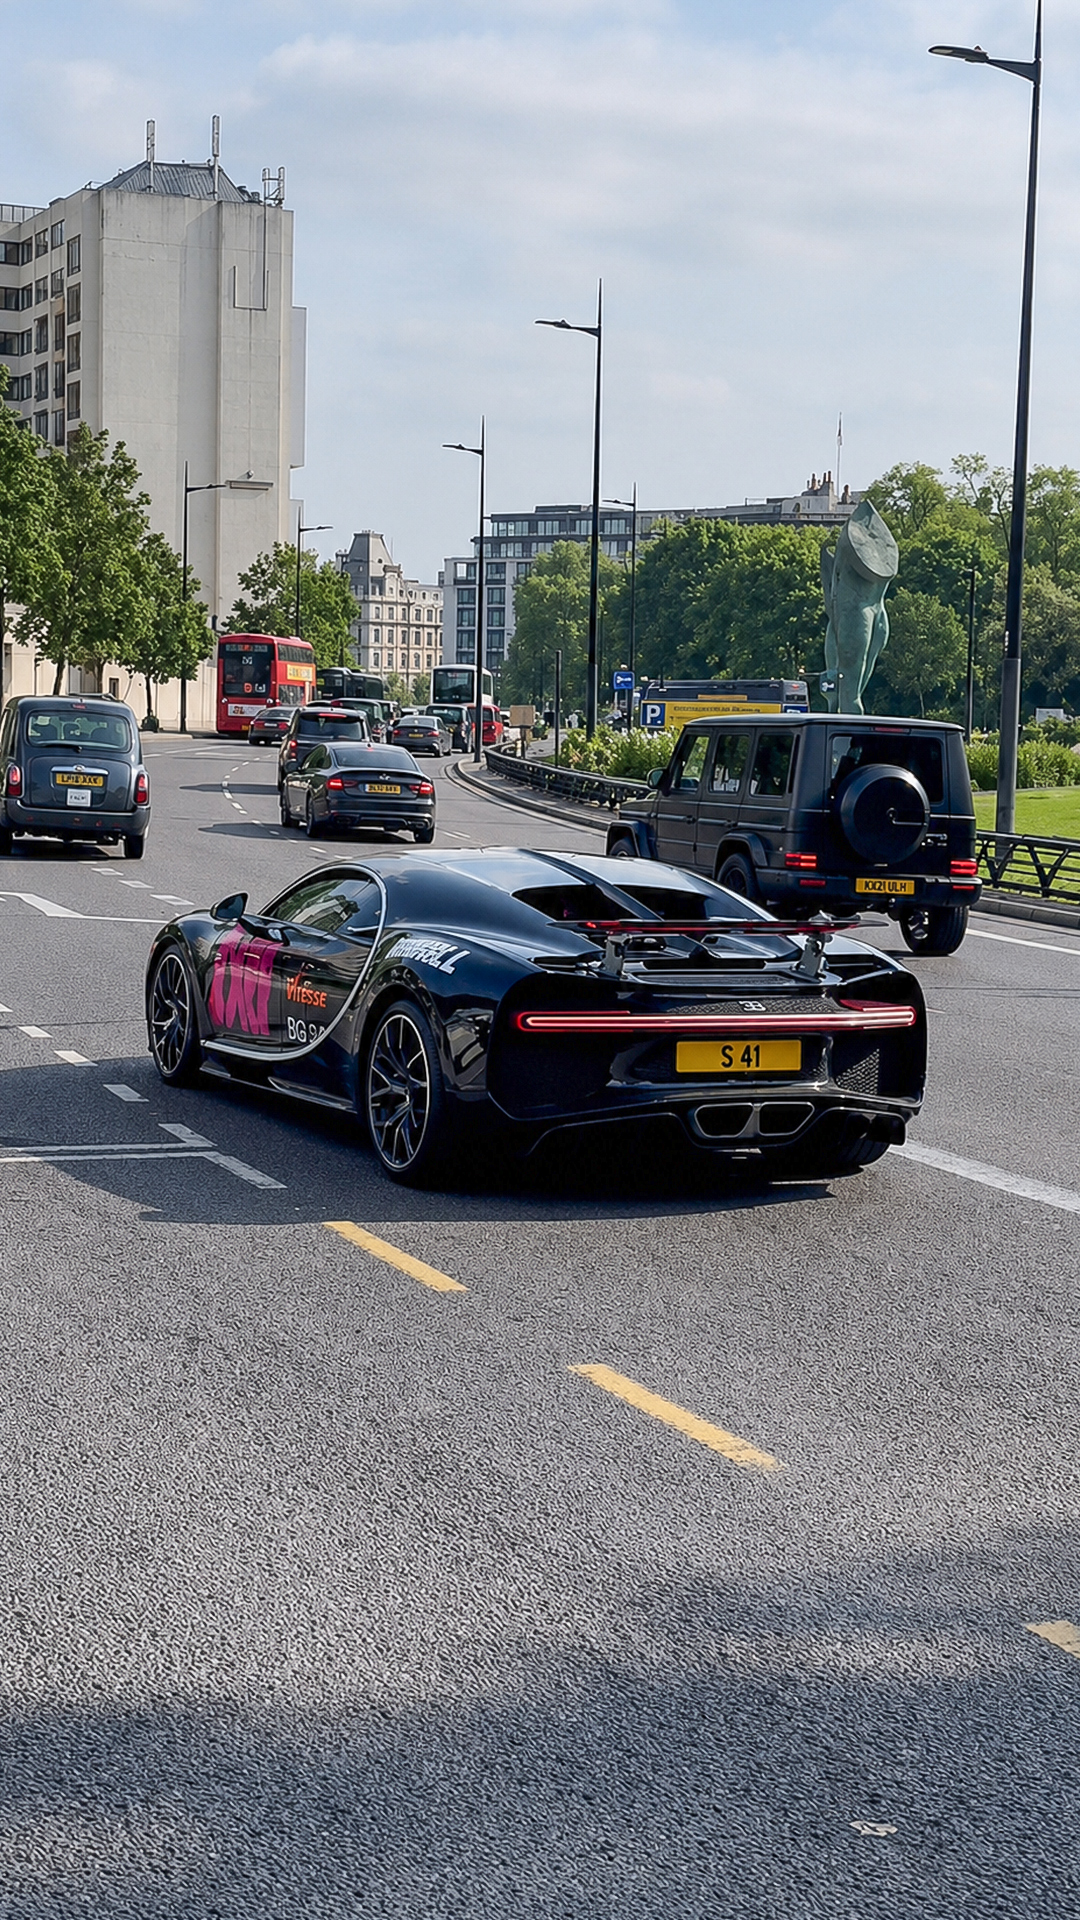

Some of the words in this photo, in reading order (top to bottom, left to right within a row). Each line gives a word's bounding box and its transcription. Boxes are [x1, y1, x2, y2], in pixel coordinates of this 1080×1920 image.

[887, 881, 907, 893] ULH
[720, 1044, 735, 1069] S
[740, 1044, 760, 1069] 41
